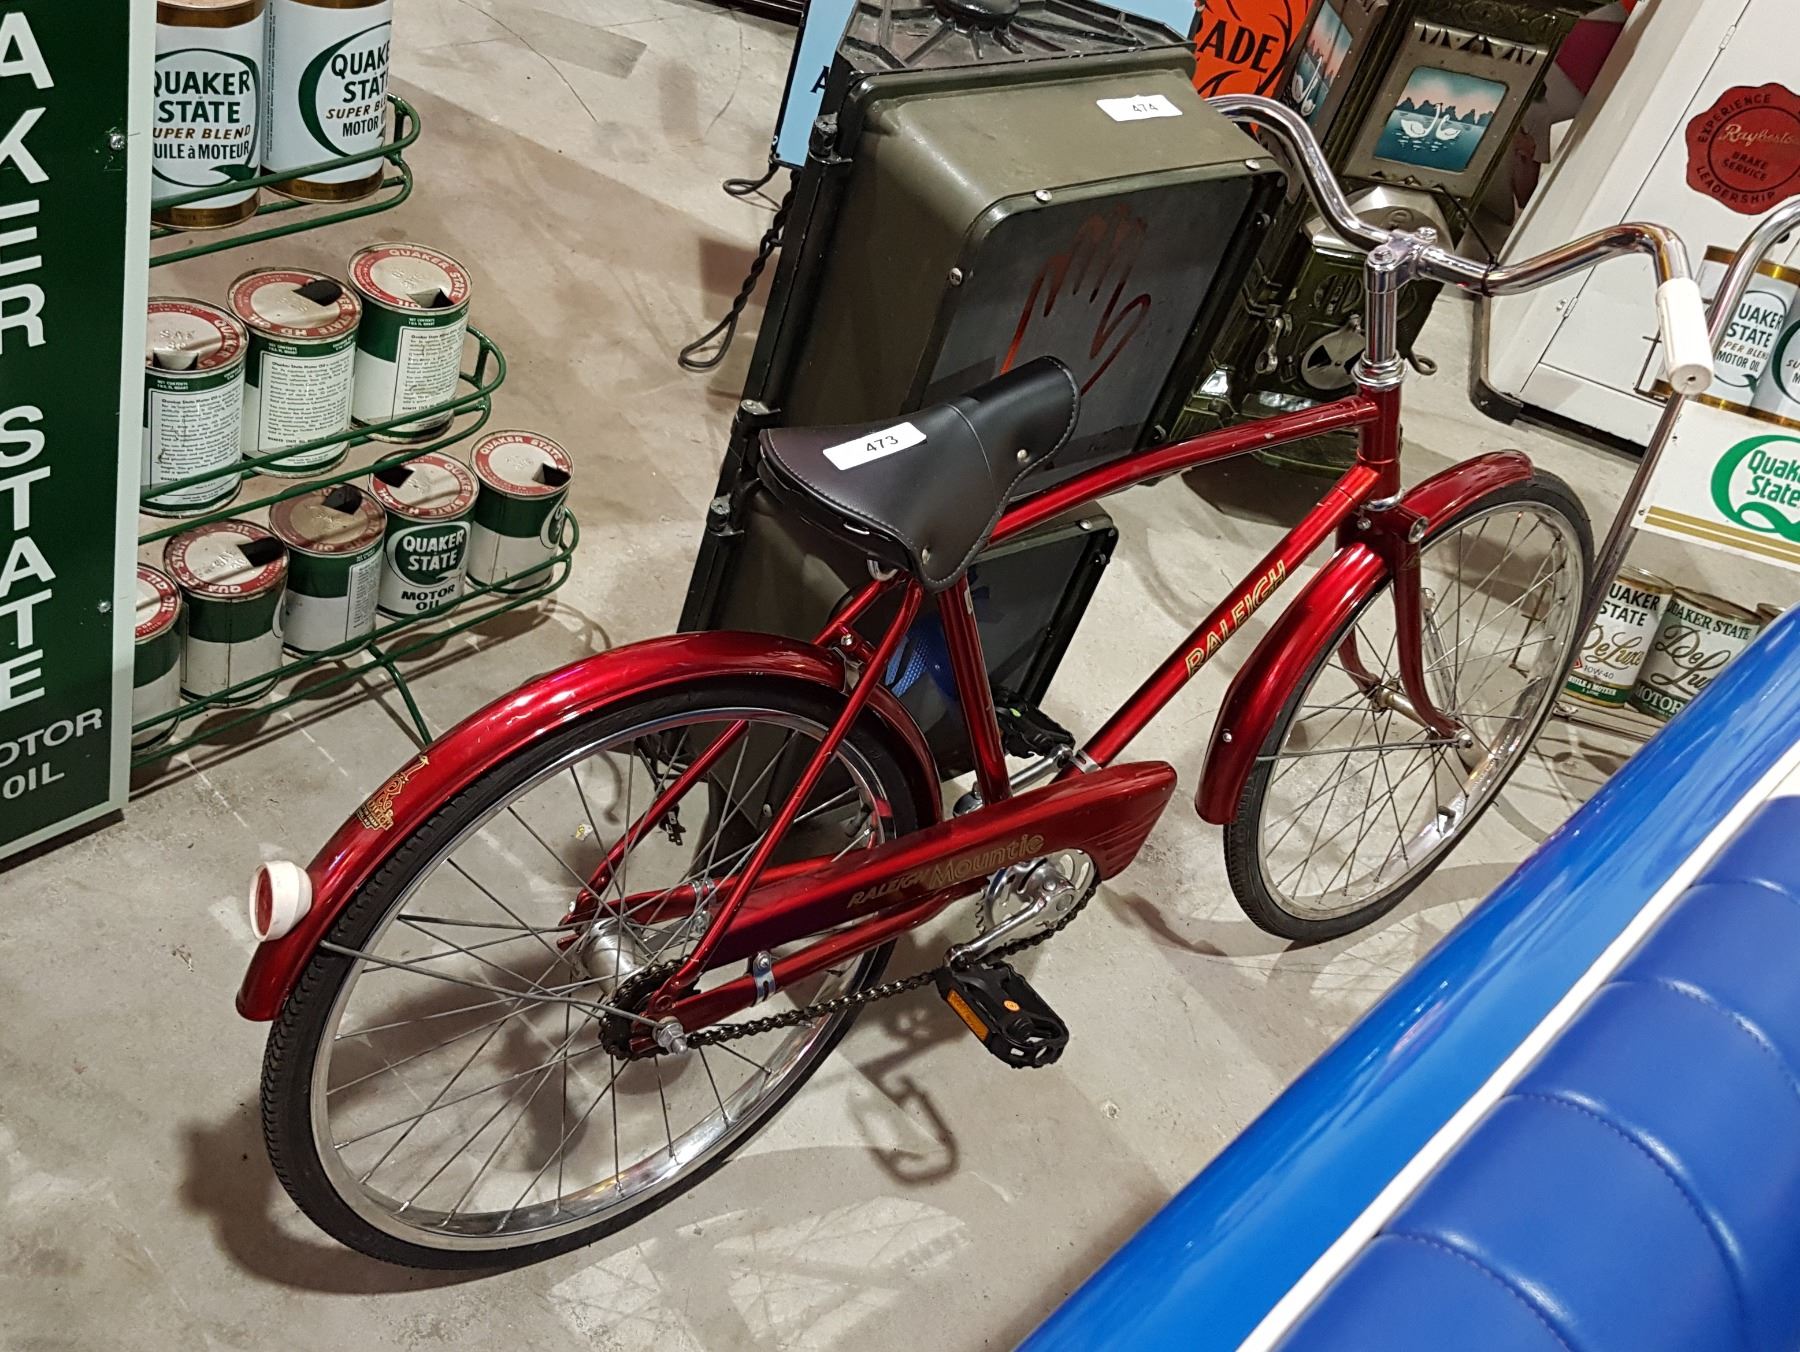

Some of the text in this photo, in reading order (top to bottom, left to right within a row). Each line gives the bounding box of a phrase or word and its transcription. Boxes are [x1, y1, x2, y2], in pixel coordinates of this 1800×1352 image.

[331, 40, 390, 79] QUAKE
[343, 72, 388, 103] STAT
[158, 100, 240, 123] STATE
[326, 104, 371, 120] SUPER
[1132, 103, 1159, 112] 474
[1698, 94, 1771, 143] EXPERIENCE
[153, 124, 250, 140] UPER BLEND
[343, 115, 379, 137] MOTOR
[1719, 123, 1797, 147] Raybesto
[154, 143, 185, 159] UILE
[198, 140, 250, 160] MOTEUR
[1732, 151, 1768, 170] BRAKE
[1723, 159, 1768, 181] SERVICE
[1696, 166, 1775, 204] LEADERSHIP
[389, 248, 450, 269] QUAKER
[449, 271, 466, 298] STATE
[318, 313, 353, 335] STATE
[1738, 303, 1784, 330] UAKER
[1727, 322, 1773, 348] STATE
[1721, 340, 1747, 354] PER
[1717, 350, 1760, 373] MOTOR OIL
[480, 436, 563, 460] QUAKER STATE
[866, 435, 899, 452] 473
[1747, 449, 1800, 484] Quak
[444, 463, 472, 497] QUAKER
[1746, 475, 1800, 507] State
[429, 500, 465, 516] STATE
[402, 529, 465, 553] QUAKER
[0, 405, 56, 712] STATE
[408, 550, 457, 571] STATE
[181, 571, 242, 593] QUAER
[401, 584, 455, 601] MOTOR
[161, 595, 176, 613] OIL
[416, 599, 440, 610] OIL
[1609, 583, 1660, 611] UAKER
[1185, 559, 1286, 678] RALEIGH
[1600, 601, 1648, 627] STATE
[1713, 620, 1752, 640] STATE
[1583, 664, 1615, 680] 10W-40
[0, 708, 103, 768] OTOR
[3, 762, 65, 799] OIL
[848, 834, 1046, 908] RALEIGH Mountie
